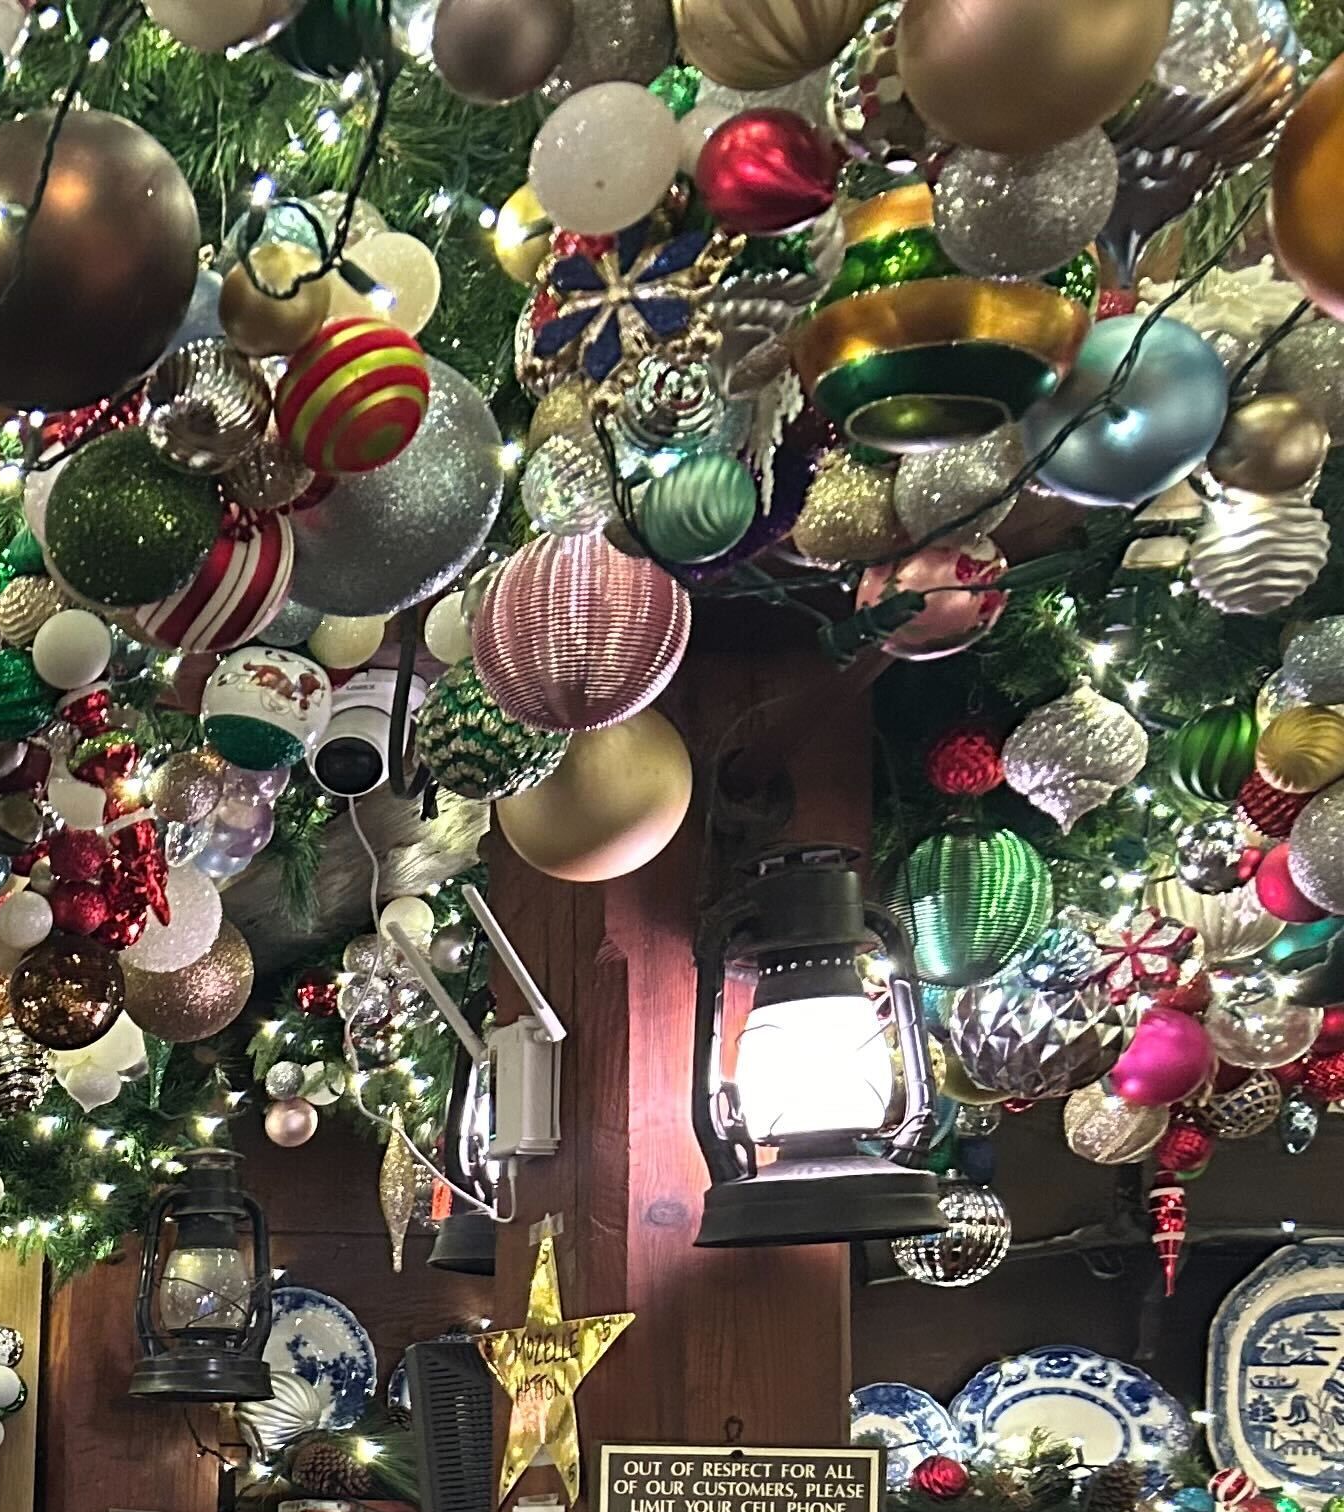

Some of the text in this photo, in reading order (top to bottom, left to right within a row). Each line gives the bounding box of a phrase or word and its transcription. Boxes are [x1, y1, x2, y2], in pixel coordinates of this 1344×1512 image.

[514, 1328, 580, 1366] MOZELLE
[515, 1368, 567, 1407] HATTON
[624, 1461, 854, 1479] OUT OF RESPECT FOR ALL
[614, 1480, 864, 1499] OF OUR CUSTOMERS, PLEASE
